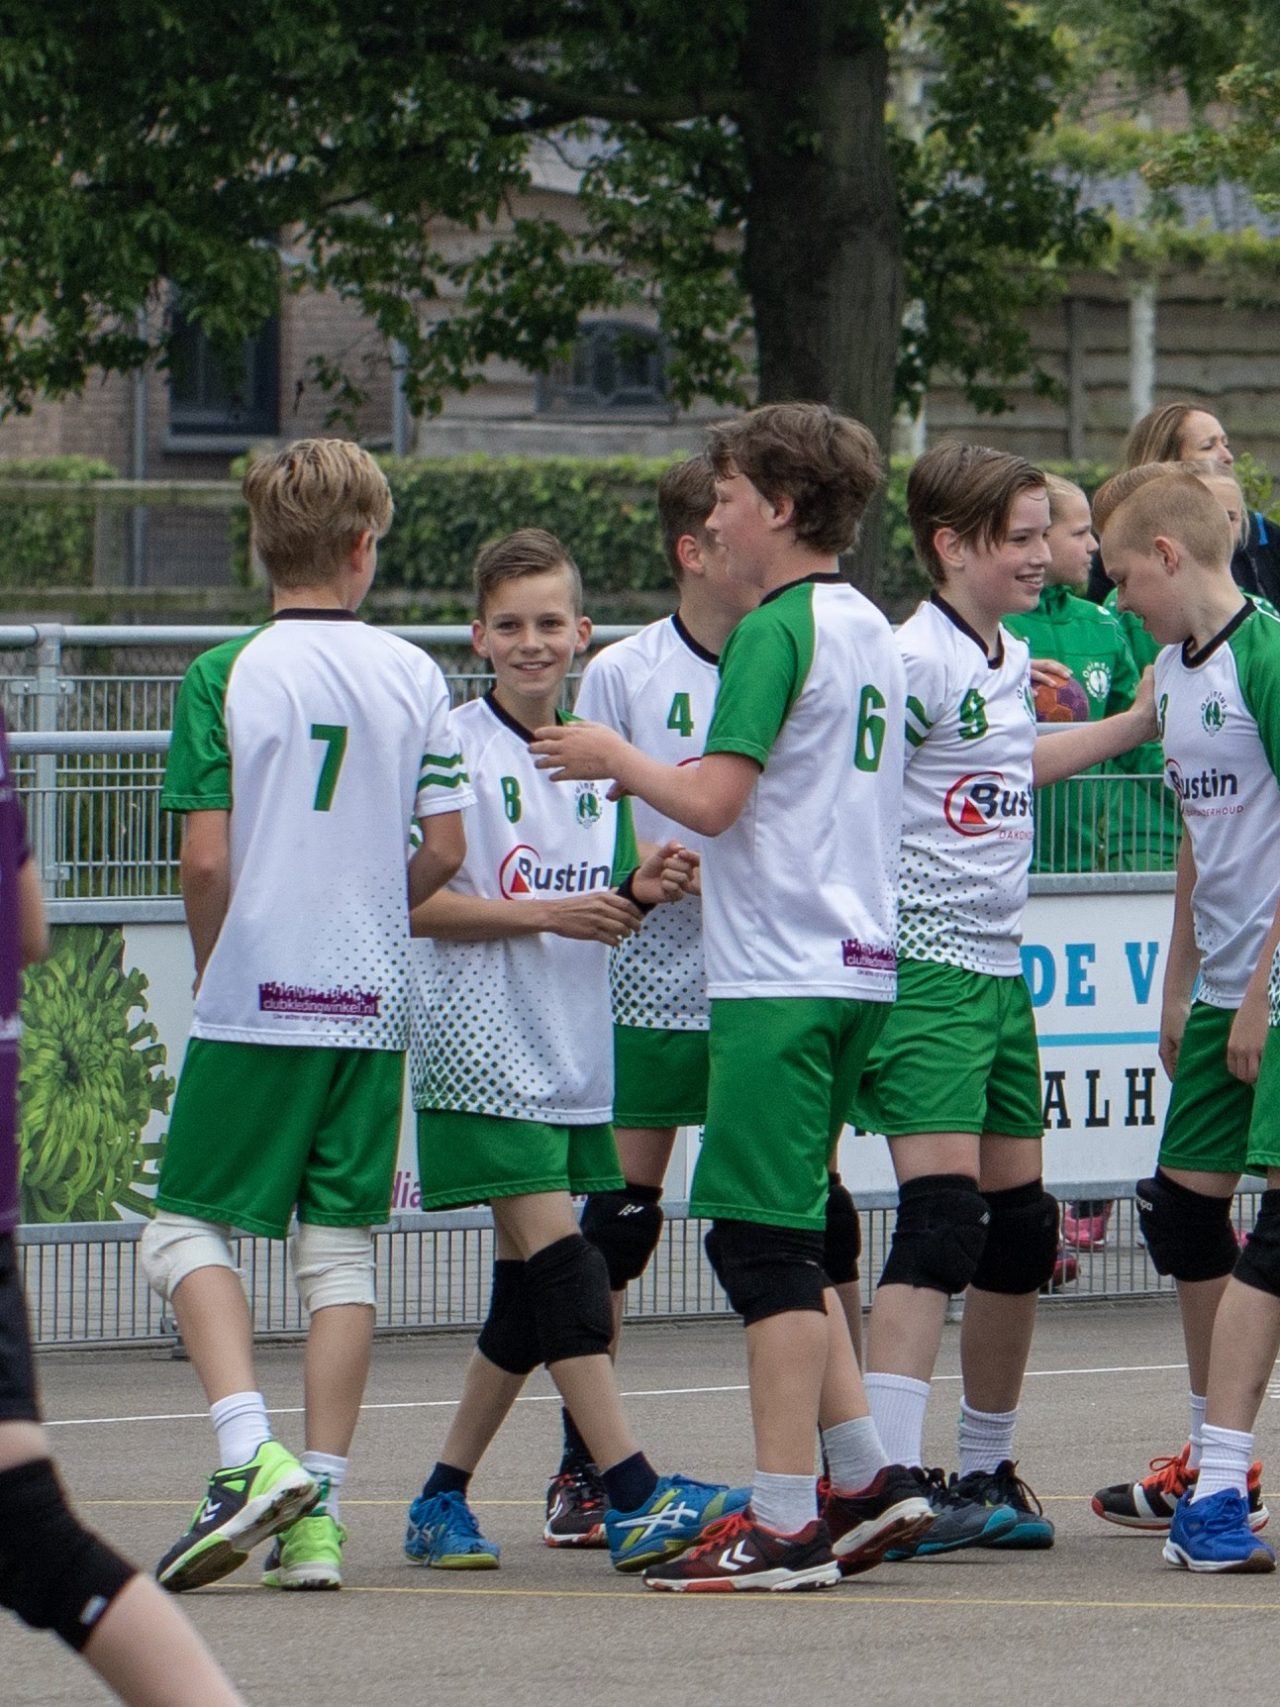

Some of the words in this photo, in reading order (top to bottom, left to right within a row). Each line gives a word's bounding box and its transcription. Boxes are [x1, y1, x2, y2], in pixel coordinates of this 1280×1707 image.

[667, 692, 695, 737] 4
[854, 684, 887, 772] 6
[958, 688, 989, 740] 9
[310, 723, 348, 812] 7
[500, 776, 522, 824] 8
[518, 856, 611, 893] Bustin
